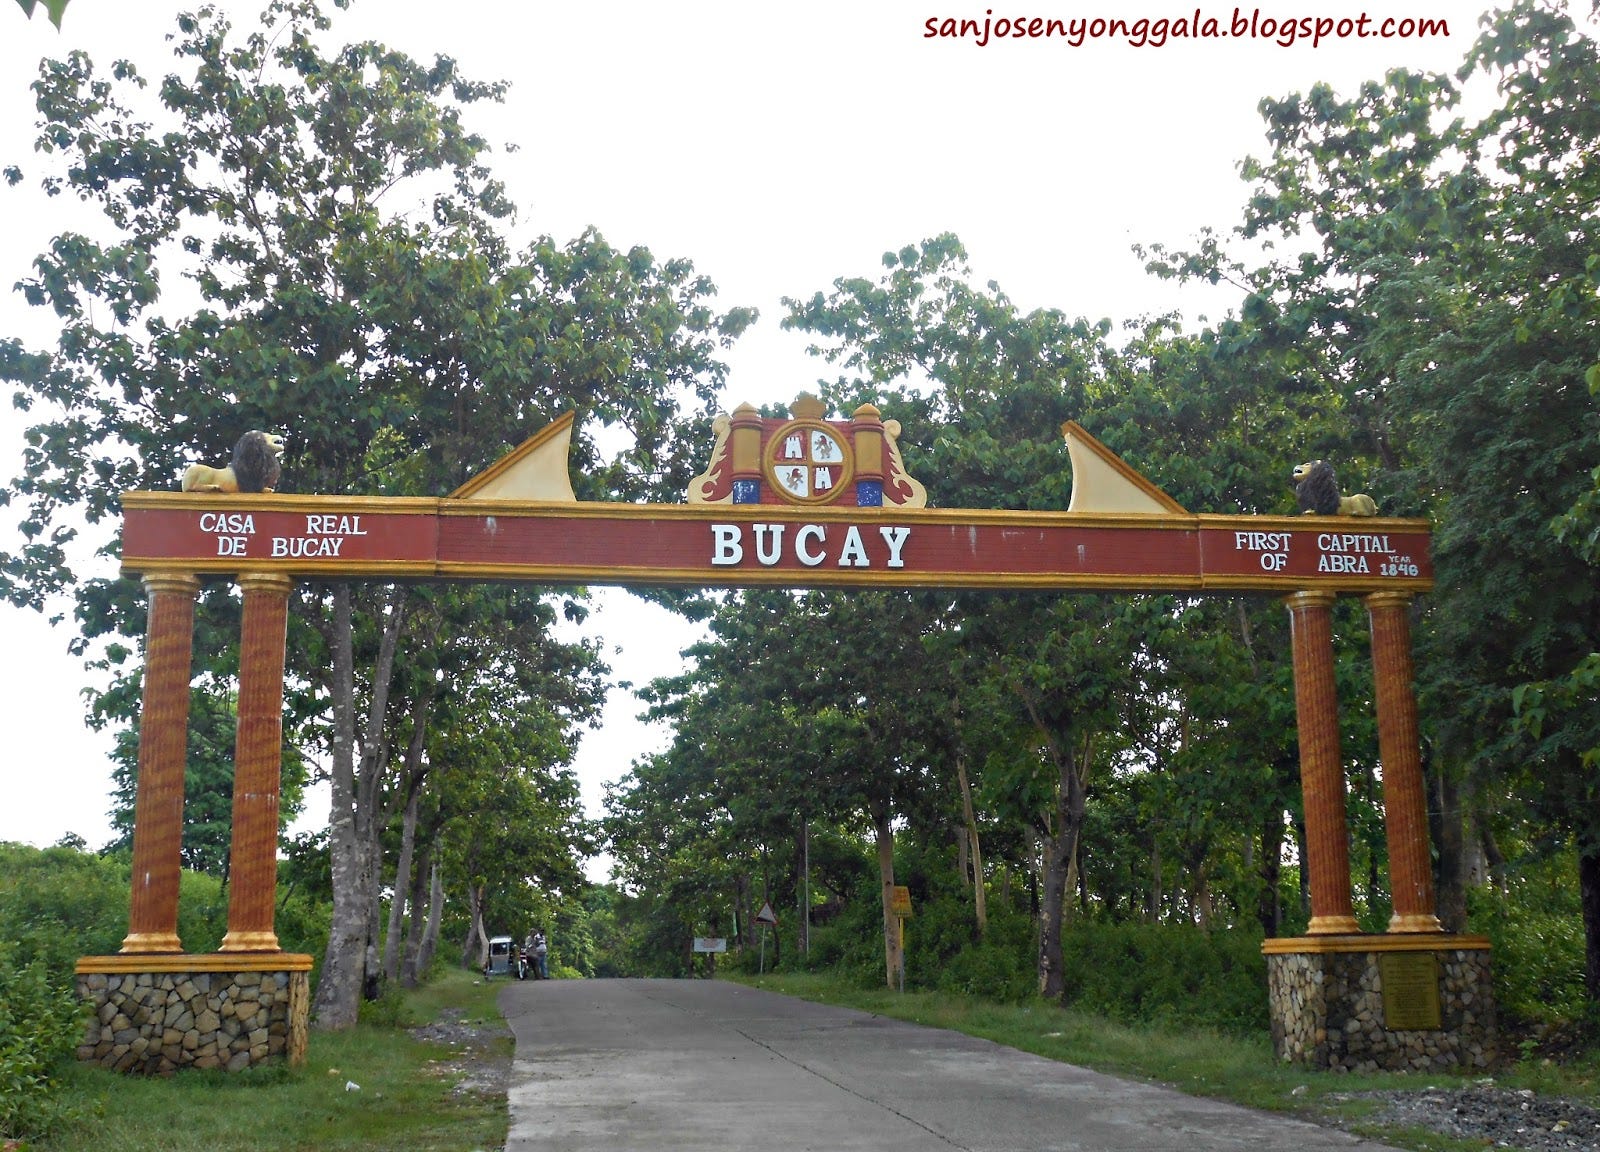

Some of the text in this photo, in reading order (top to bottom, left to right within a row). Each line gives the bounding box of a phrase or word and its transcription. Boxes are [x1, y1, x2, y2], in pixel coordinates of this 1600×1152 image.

[199, 513, 367, 536] CASA REAL
[217, 536, 344, 558] DE BUCAY
[711, 524, 911, 568] BUCAY
[1235, 532, 1396, 554] FIRST CAPITAL
[1260, 553, 1370, 574] OF ABRA
[1380, 563, 1419, 577] 1846
[1388, 555, 1411, 563] YEAR
